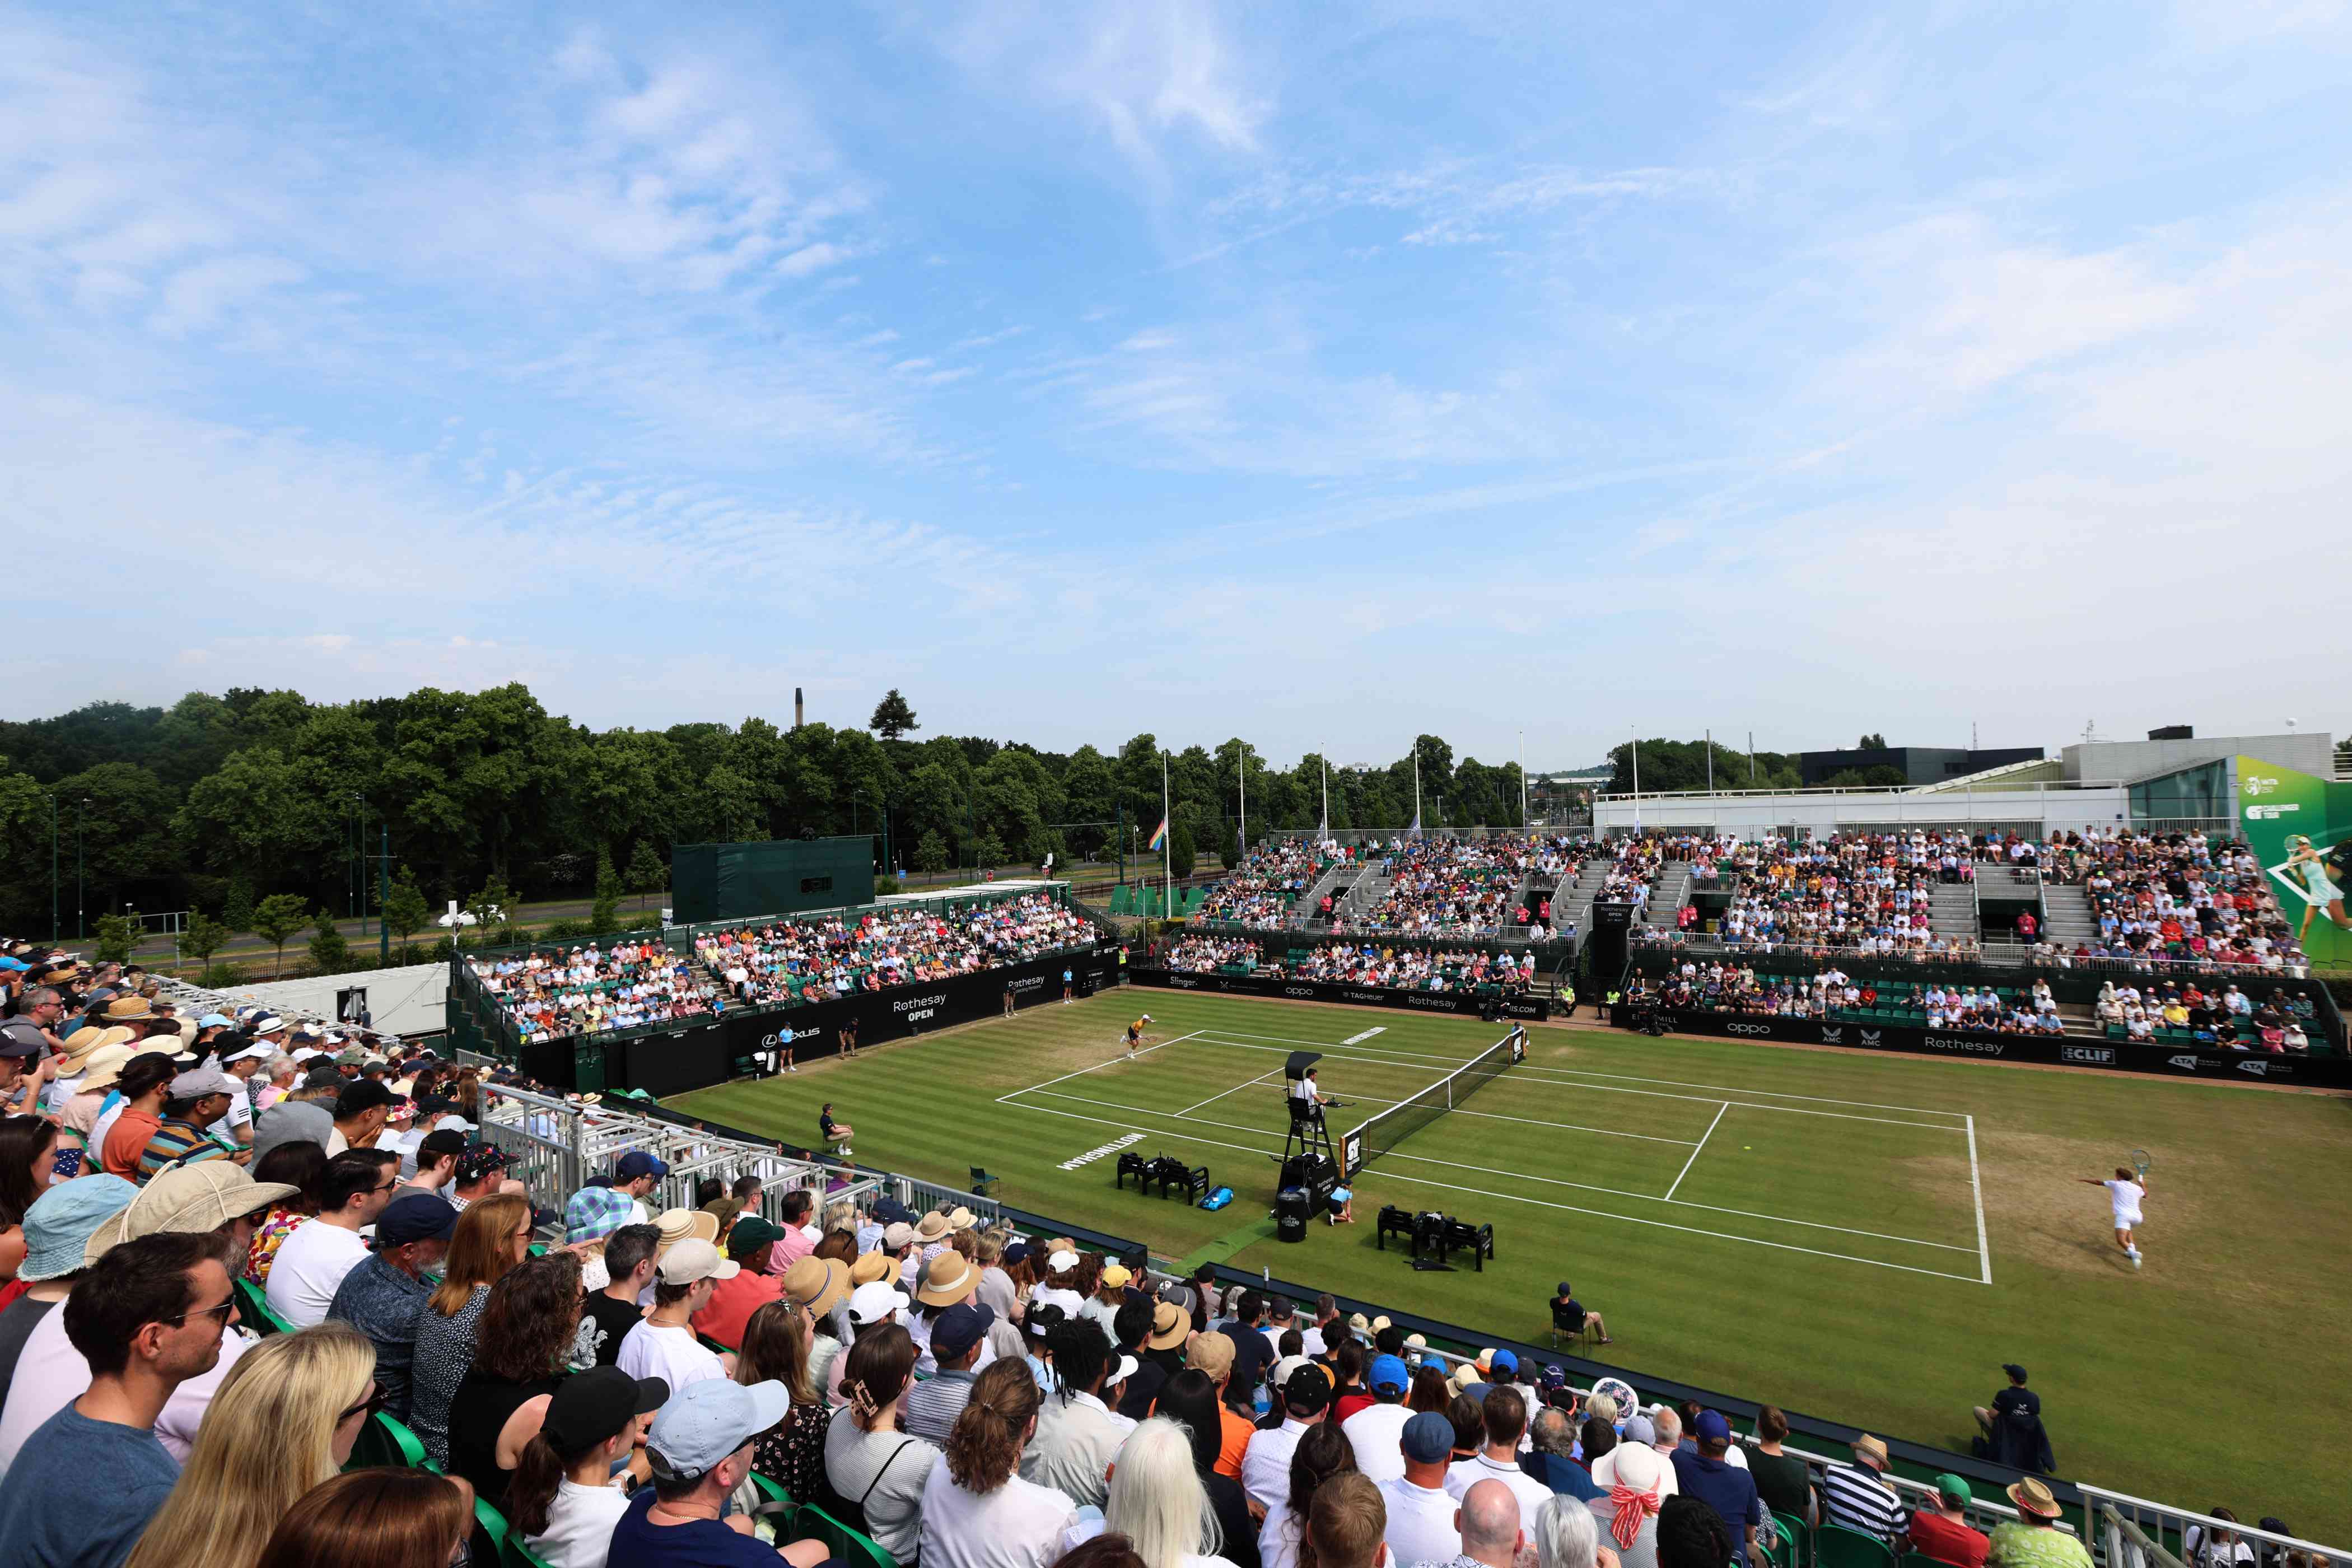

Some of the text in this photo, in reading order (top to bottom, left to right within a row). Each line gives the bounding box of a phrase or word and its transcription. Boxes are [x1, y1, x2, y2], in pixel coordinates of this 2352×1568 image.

[1009, 976, 1044, 988] Rothesay
[1286, 987, 1313, 996] oppo
[893, 994, 946, 1012] Rothesay
[1408, 996, 1457, 1010] Rothesay
[908, 1009, 934, 1021] OPEN
[791, 1027, 820, 1040] EXUS
[1727, 1023, 1770, 1034] oppo
[1925, 1037, 2004, 1055] Rothesay
[2074, 1048, 2111, 1062] CLIF
[2174, 1058, 2196, 1068] LTA
[2243, 1063, 2267, 1073] LTA
[1056, 1133, 1147, 1171] NOTTINGHAM
[1317, 1175, 1334, 1189] Rothesay
[1322, 1183, 1331, 1192] OPEN
